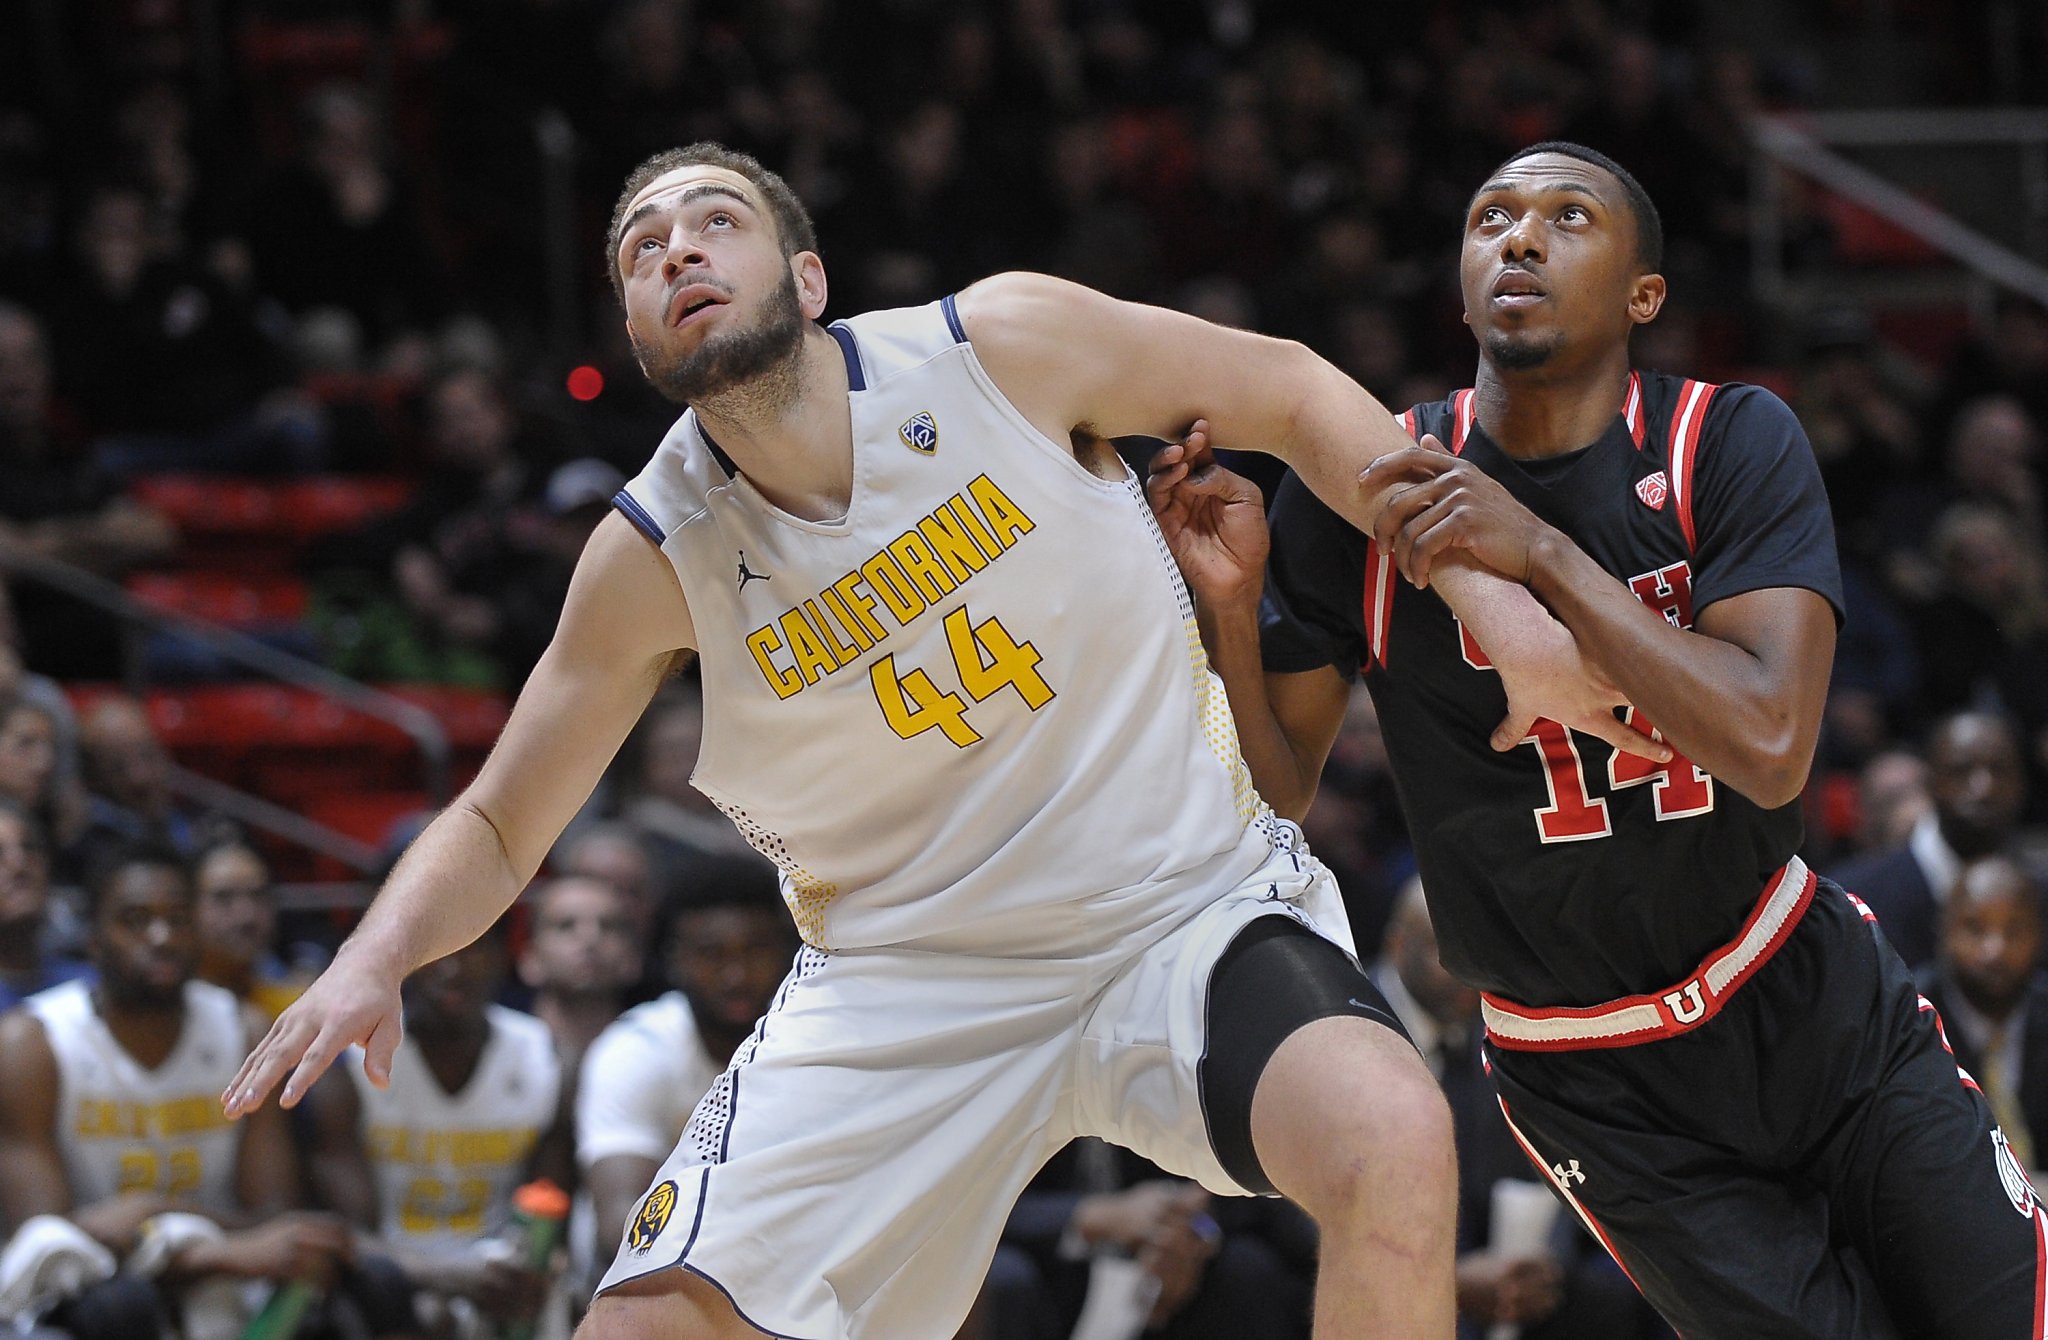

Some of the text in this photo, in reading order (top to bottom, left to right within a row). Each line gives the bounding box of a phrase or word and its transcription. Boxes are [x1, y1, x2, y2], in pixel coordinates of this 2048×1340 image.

[899, 411, 936, 446] PAC
[914, 428, 936, 449] 12
[1635, 471, 1668, 503] PAC
[1646, 487, 1666, 507] 12
[746, 472, 1037, 700] CALIFORNIA
[868, 603, 1057, 749] 44
[1518, 704, 1714, 844] 14
[1661, 978, 1707, 1025] U
